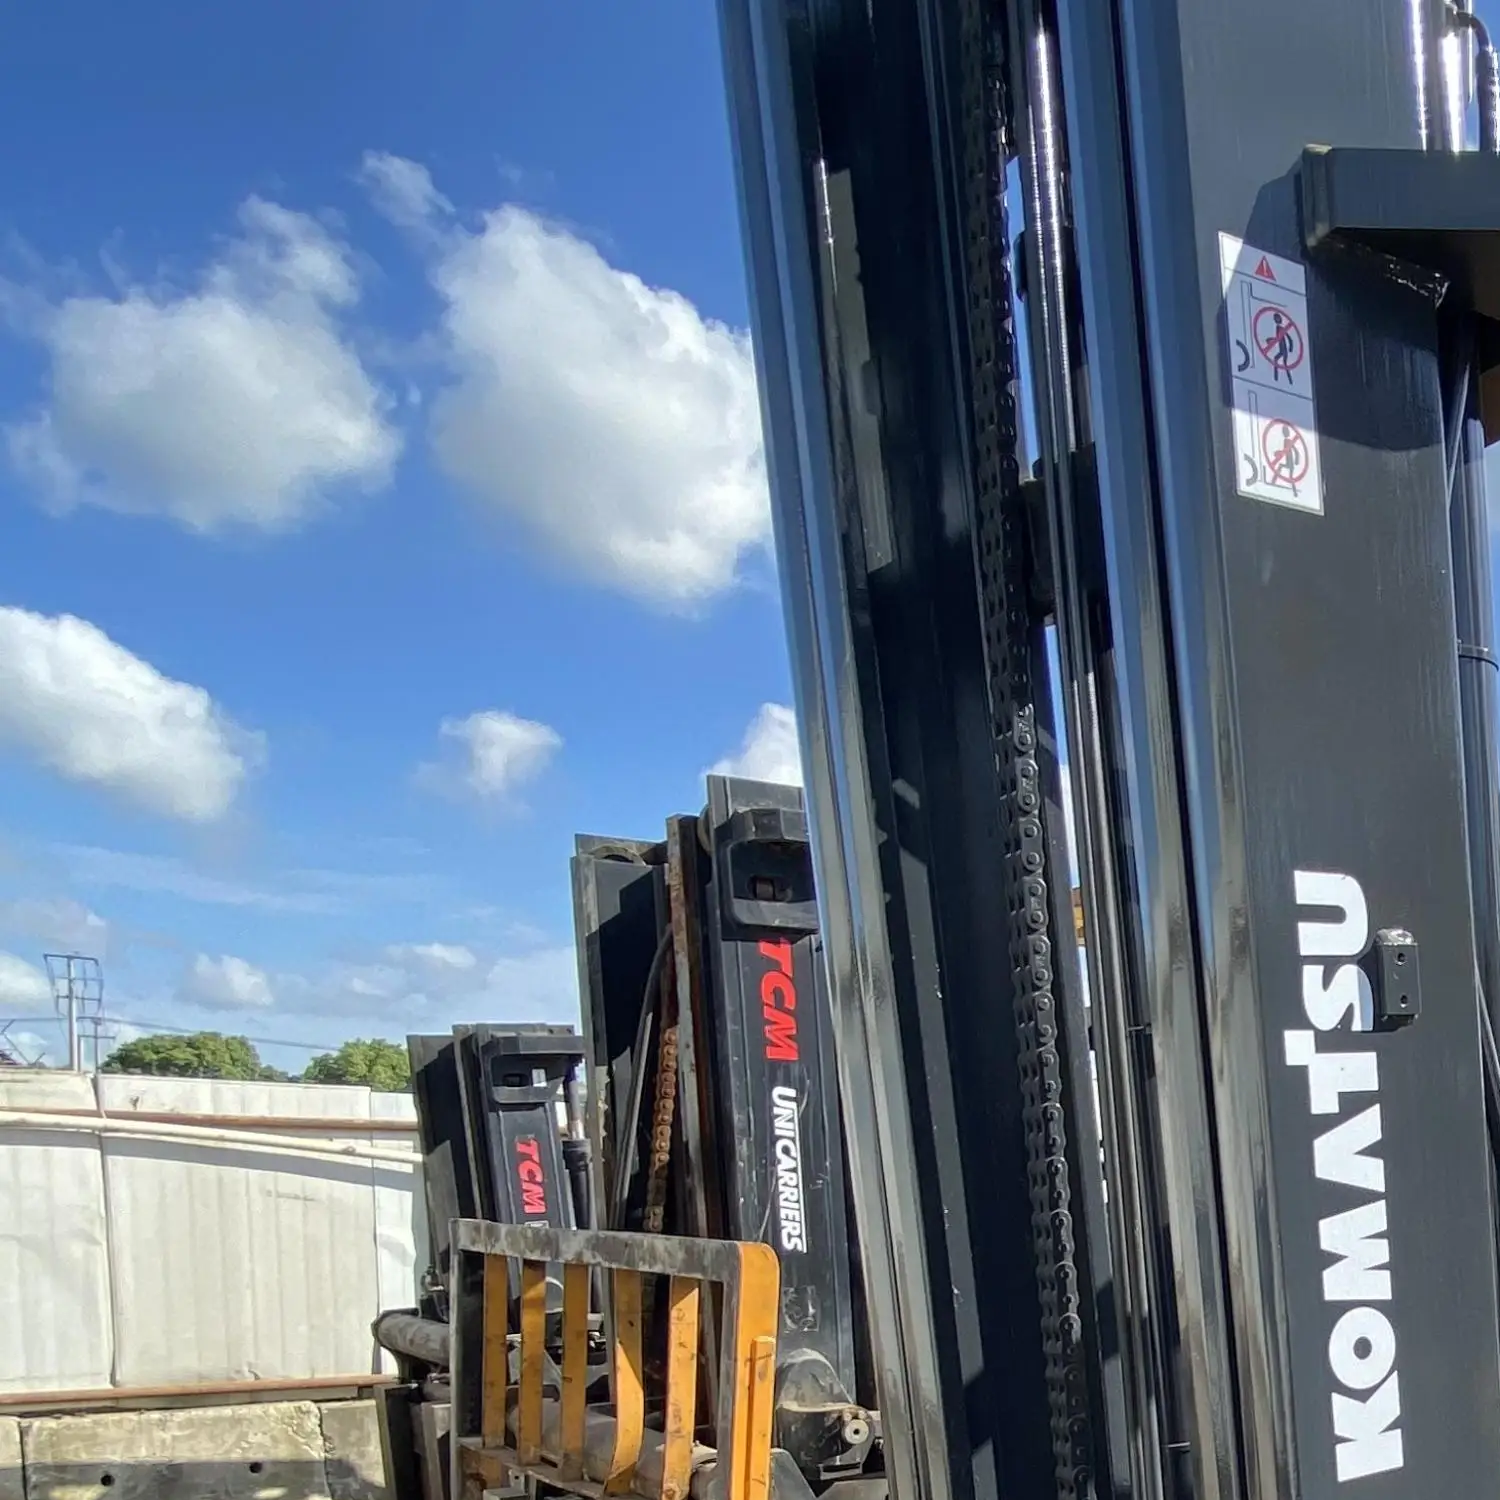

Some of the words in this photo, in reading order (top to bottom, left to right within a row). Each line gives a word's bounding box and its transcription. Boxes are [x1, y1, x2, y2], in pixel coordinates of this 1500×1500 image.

[759, 938, 799, 1062] TCM
[516, 1138, 546, 1213] TCM
[772, 1086, 807, 1254] UNICARRIERS
[1284, 869, 1404, 1483] KOMATSU
